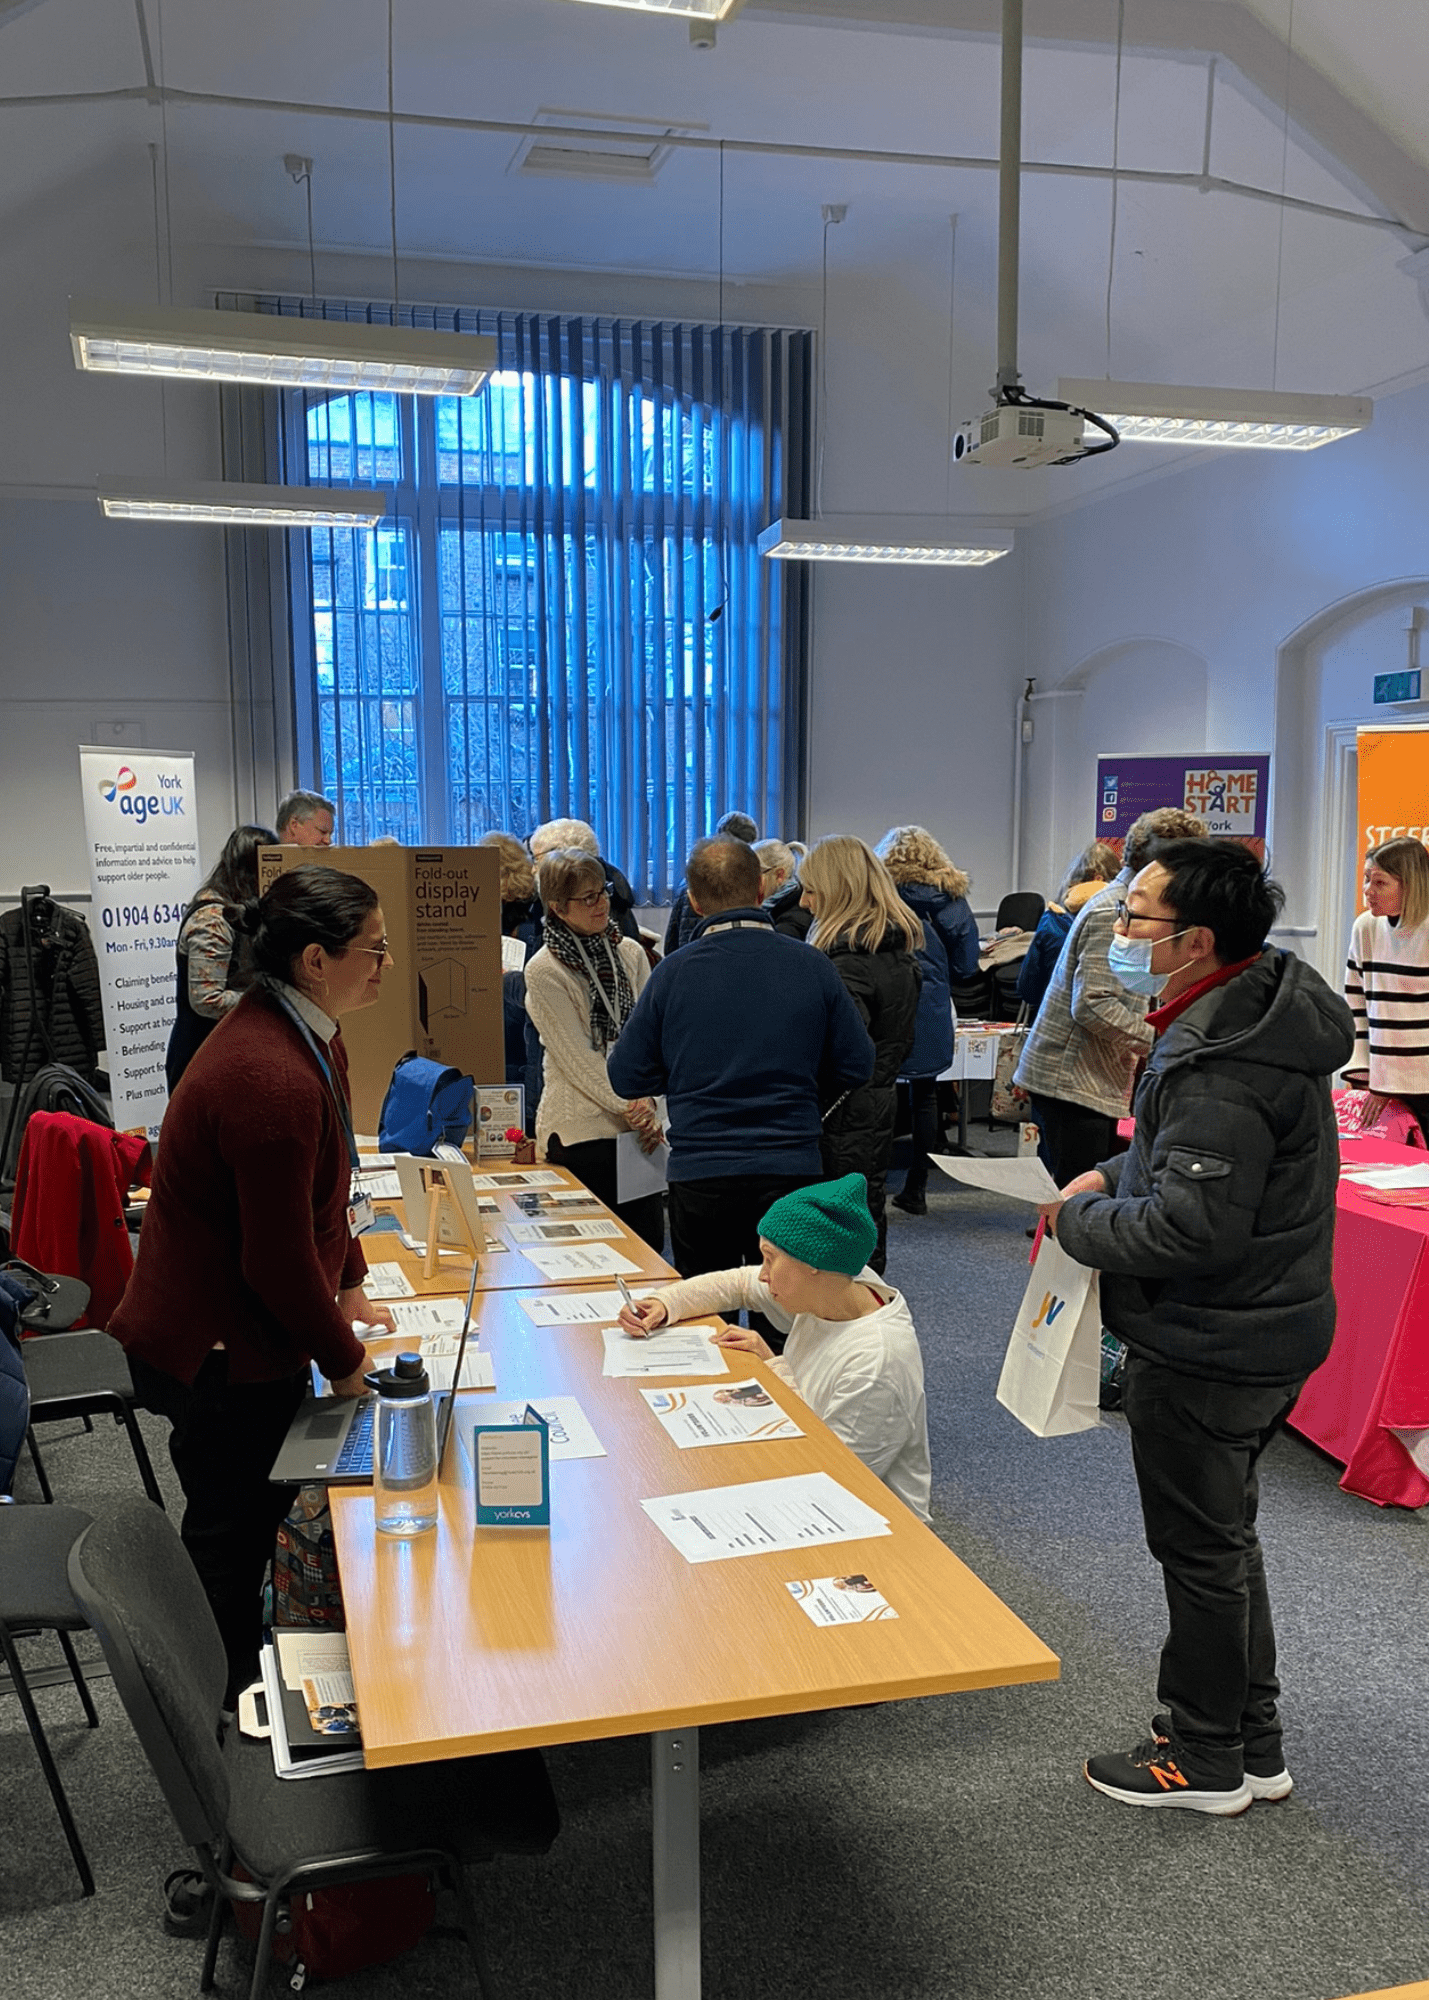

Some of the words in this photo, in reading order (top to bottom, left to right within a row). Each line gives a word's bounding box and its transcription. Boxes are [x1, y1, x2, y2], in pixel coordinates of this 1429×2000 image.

[157, 774, 182, 789] York
[1186, 769, 1257, 793] HOME
[1185, 786, 1256, 814] START
[120, 795, 160, 824] age
[161, 796, 185, 815] UK
[94, 843, 115, 854] Free,
[115, 842, 145, 854] impartial
[146, 842, 159, 852] and
[159, 840, 197, 852] confidential
[96, 857, 138, 868] information
[138, 856, 151, 867] and
[152, 855, 174, 866] advice
[174, 855, 183, 865] to
[183, 854, 197, 866] help
[97, 873, 126, 885] support
[127, 871, 144, 882] older
[145, 869, 171, 883] people.
[415, 867, 468, 879] Fold-out
[415, 881, 480, 902] display
[102, 905, 149, 928] 01904
[416, 900, 467, 918] stand
[106, 942, 129, 954] Mon
[115, 976, 150, 989] Claiming
[117, 998, 150, 1011] Housing
[150, 995, 165, 1007] and
[166, 996, 176, 1004] ca
[119, 1020, 151, 1036] Support
[152, 1019, 161, 1029] at
[121, 1041, 166, 1056] Befriending
[123, 1065, 156, 1080] Support
[156, 1062, 166, 1072] fo
[126, 1089, 143, 1101] Plus
[143, 1083, 166, 1097] much
[493, 1507, 531, 1521] yorkcvs
